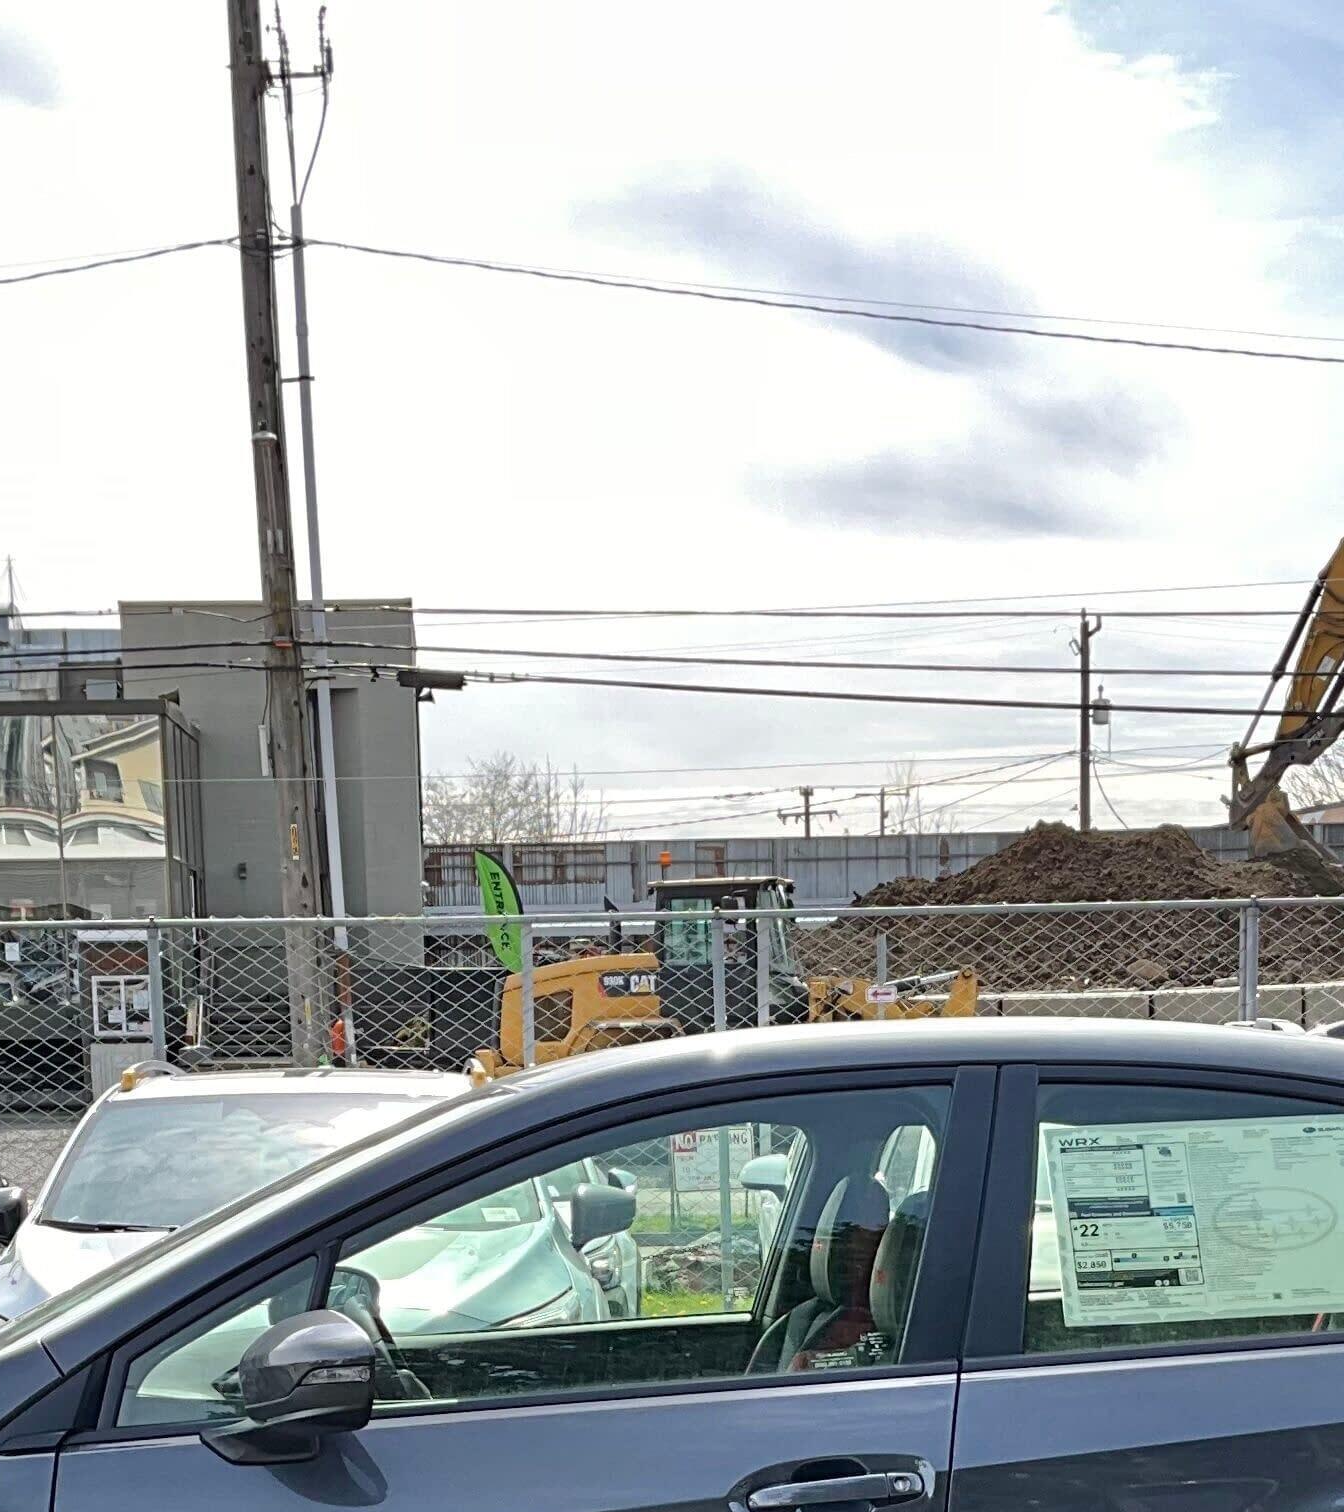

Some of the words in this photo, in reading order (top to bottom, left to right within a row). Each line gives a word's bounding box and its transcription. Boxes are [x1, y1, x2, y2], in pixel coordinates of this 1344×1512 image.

[490, 871, 510, 951] ENTRCE
[630, 975, 656, 992] CAT
[1058, 1137, 1100, 1147] WRX
[1079, 1224, 1099, 1237] 22
